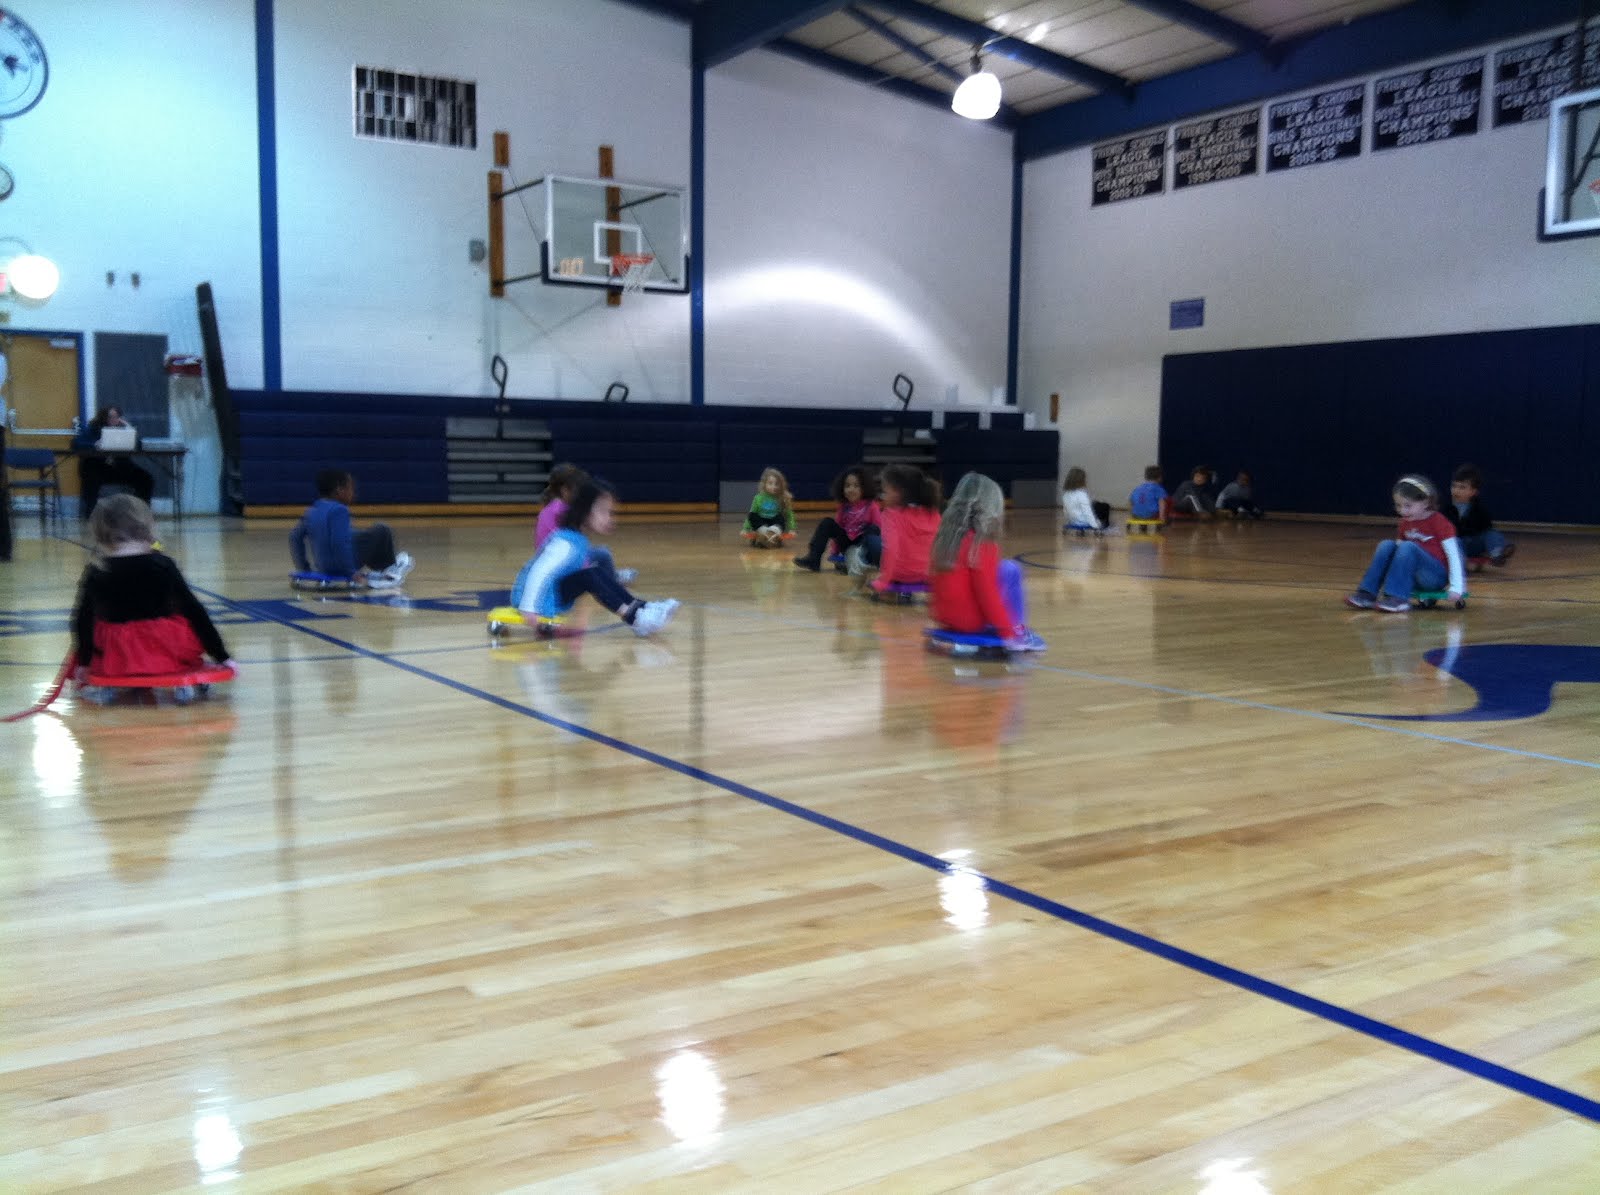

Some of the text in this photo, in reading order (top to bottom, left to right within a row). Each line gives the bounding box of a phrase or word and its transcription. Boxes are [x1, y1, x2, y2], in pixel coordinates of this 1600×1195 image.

[1430, 60, 1482, 83] SCHOOLS
[1318, 87, 1363, 108] SCHOOLS
[1393, 78, 1460, 104] LEAGUE
[1286, 105, 1345, 128] LEAGUE
[1375, 89, 1480, 122] BOYS BASKETBALL
[1218, 111, 1258, 130] SCHOOLS
[1268, 114, 1362, 144] GIRLS BASKETBALL
[1379, 104, 1472, 135] CHAMPIONS
[1130, 133, 1166, 149] SCHOOLS
[1190, 129, 1241, 149] LEAGUE
[1200, 135, 1258, 159] BASKETBALL
[1274, 130, 1355, 157] CHAMPIONS
[1106, 148, 1149, 168] LEAGUE
[1115, 157, 1164, 179] BASKETBALL
[1180, 150, 1251, 174] CHAMPIONS
[1097, 170, 1159, 192] CHAMPIONS
